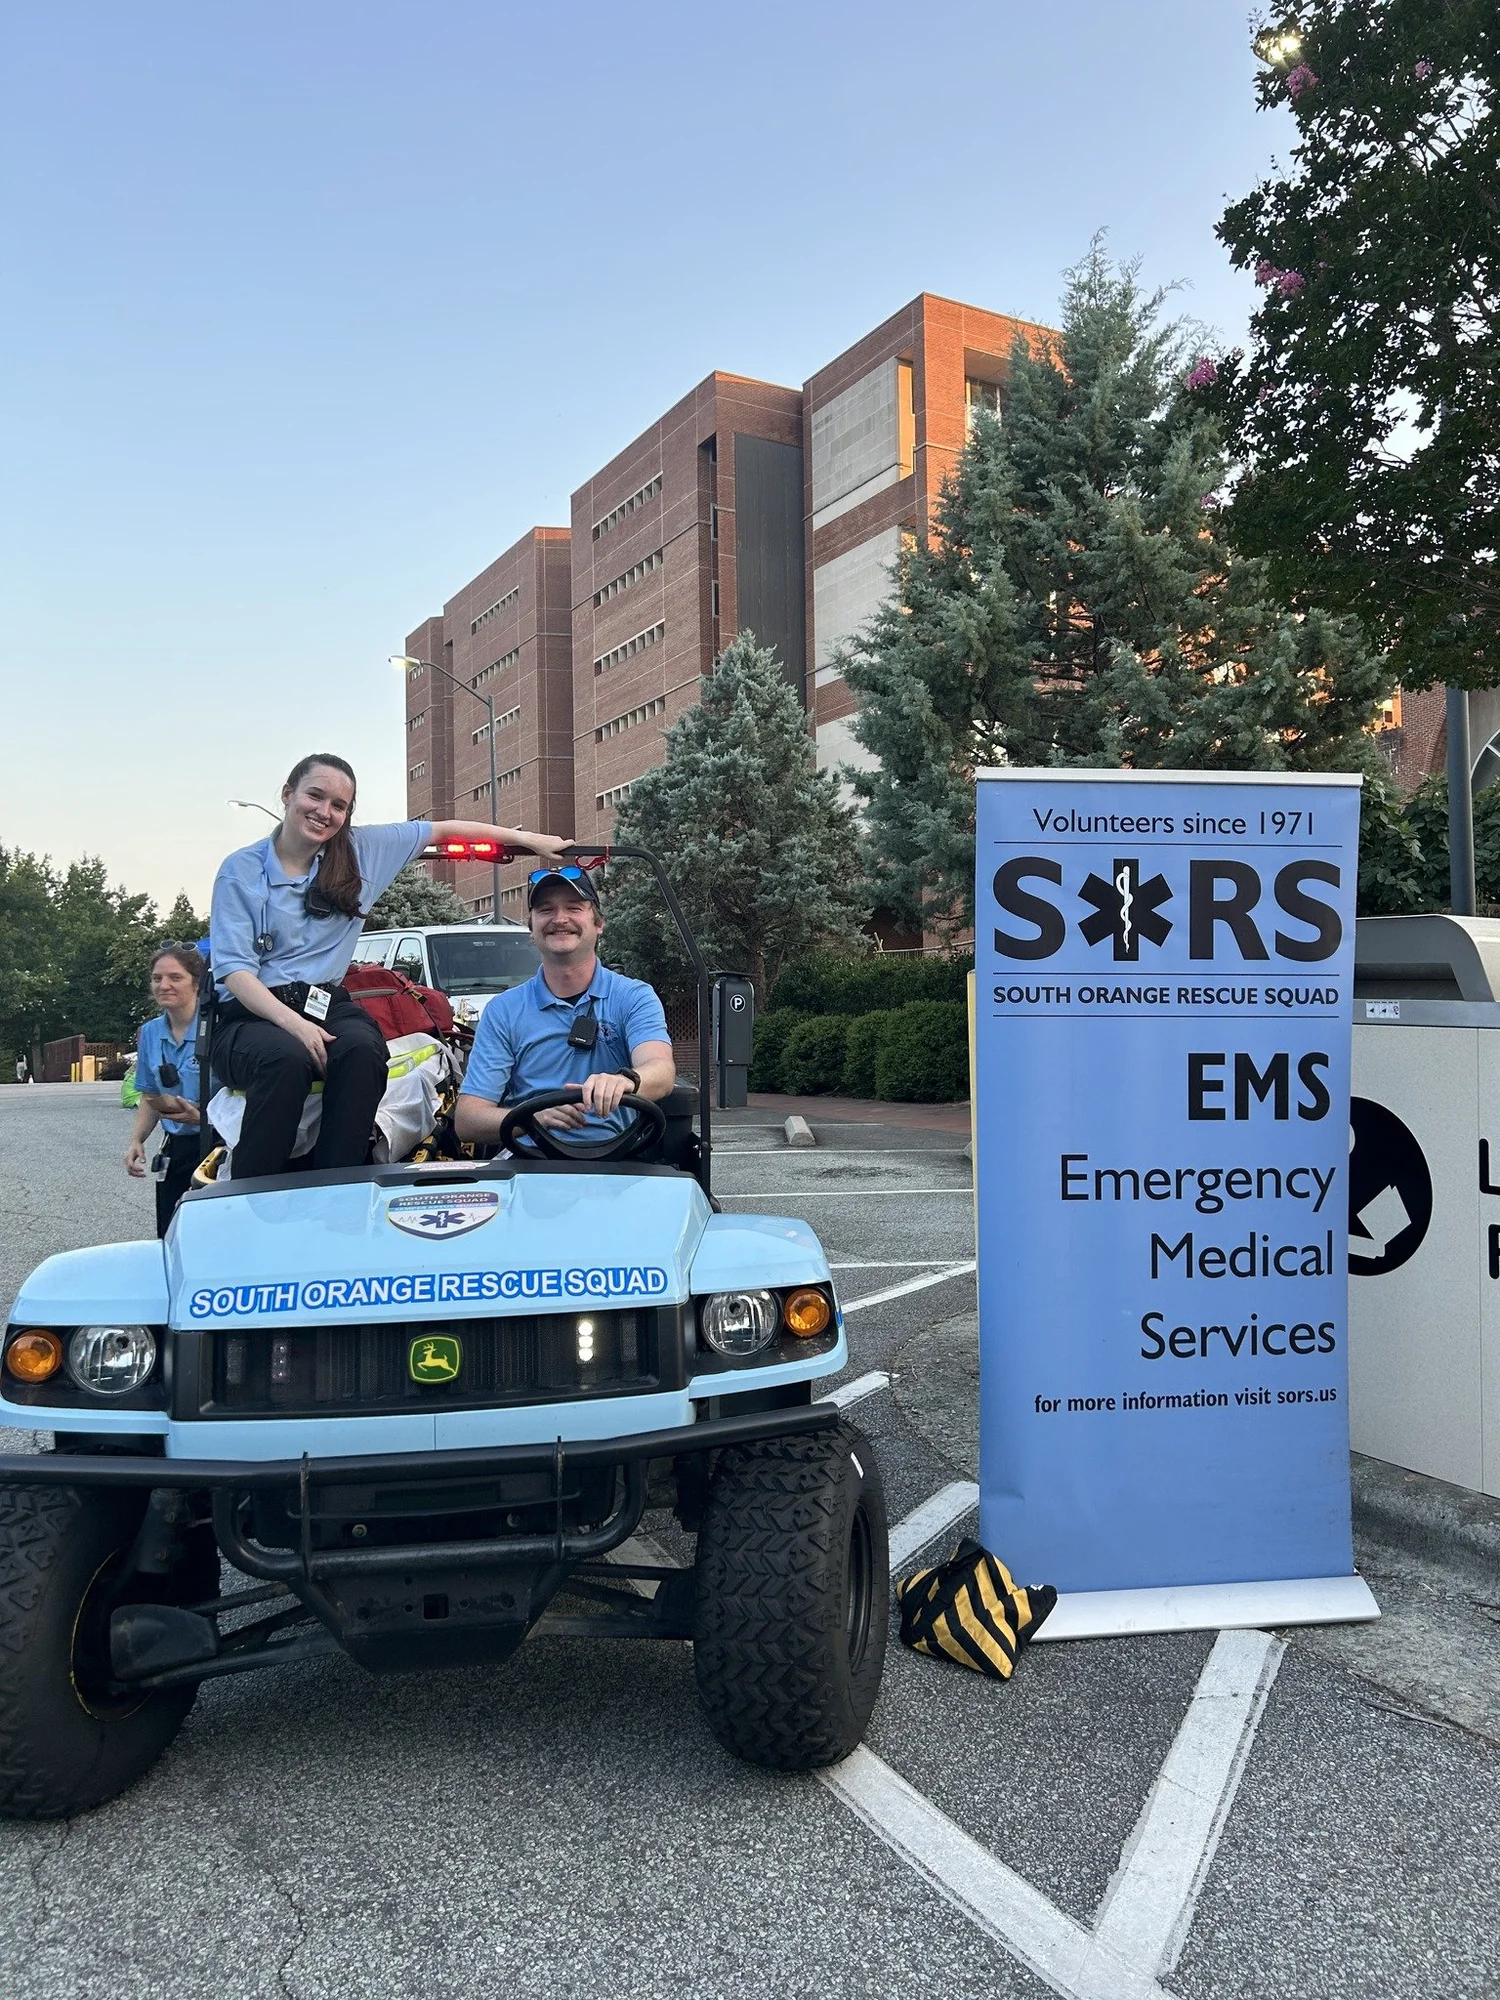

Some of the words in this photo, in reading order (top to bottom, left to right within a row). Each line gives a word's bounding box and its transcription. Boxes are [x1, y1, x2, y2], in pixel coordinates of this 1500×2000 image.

[1032, 808, 1175, 834] Volunteers
[1182, 812, 1247, 835] since
[1260, 811, 1313, 836] 1971
[992, 856, 1343, 963] SRS
[993, 986, 1071, 1004] SOUTH
[1077, 986, 1171, 1005] ORANGE
[1177, 987, 1258, 1005] RESCUE
[1264, 987, 1339, 1007] SQUAD
[1187, 1051, 1331, 1122] EMS
[1060, 1154, 1337, 1214] Emergency
[1150, 1229, 1334, 1280] Medical
[190, 1283, 298, 1318] SOUTH
[303, 1275, 434, 1308] ORANGE
[439, 1270, 561, 1300] RESCUE
[566, 1268, 667, 1296] SQUAD
[1140, 1311, 1336, 1360] Services
[1034, 1394, 1062, 1413] for
[1067, 1396, 1116, 1412] more
[1122, 1388, 1229, 1411] information
[1233, 1386, 1272, 1406] visit
[1276, 1386, 1337, 1405] sors.us
